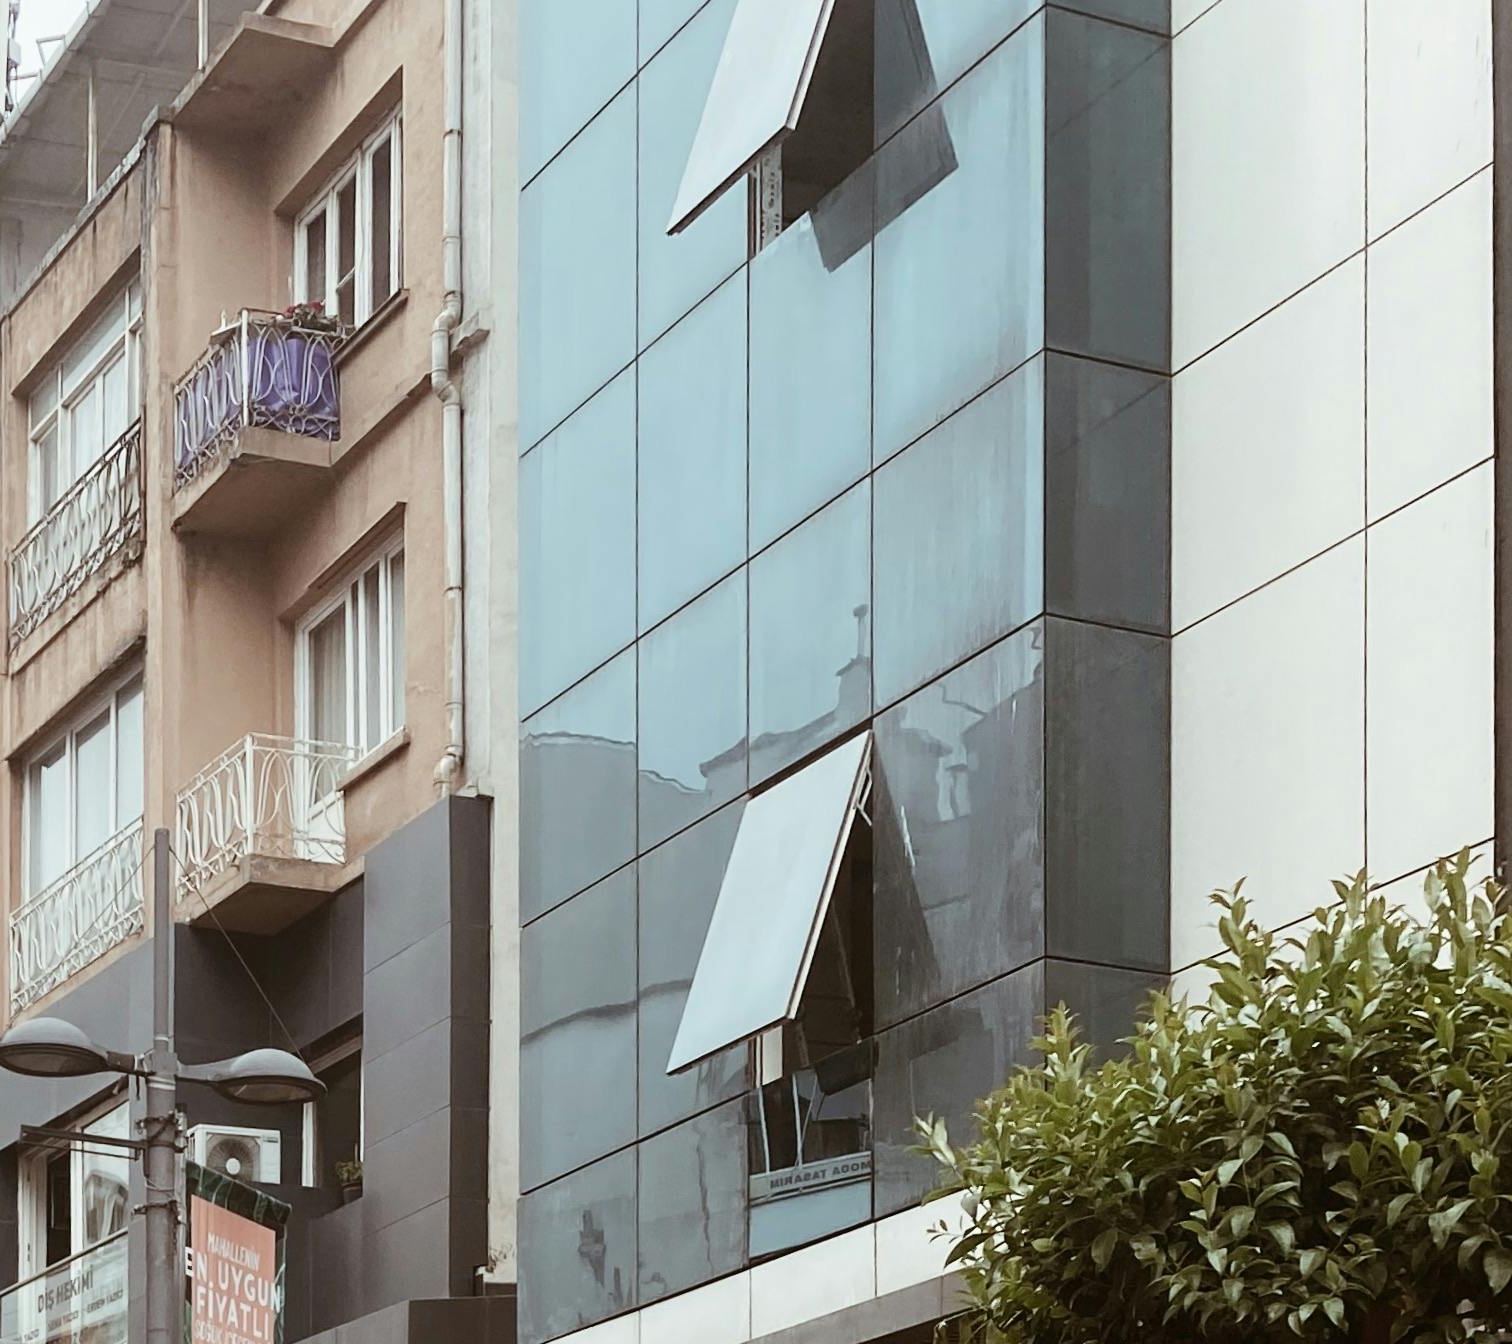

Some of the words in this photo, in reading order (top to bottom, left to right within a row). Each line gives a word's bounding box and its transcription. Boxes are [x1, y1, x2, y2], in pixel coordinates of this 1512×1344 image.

[184, 1246, 208, 1282] EN
[218, 1260, 282, 1314] UYGUN
[196, 1281, 270, 1341] FİYATLI
